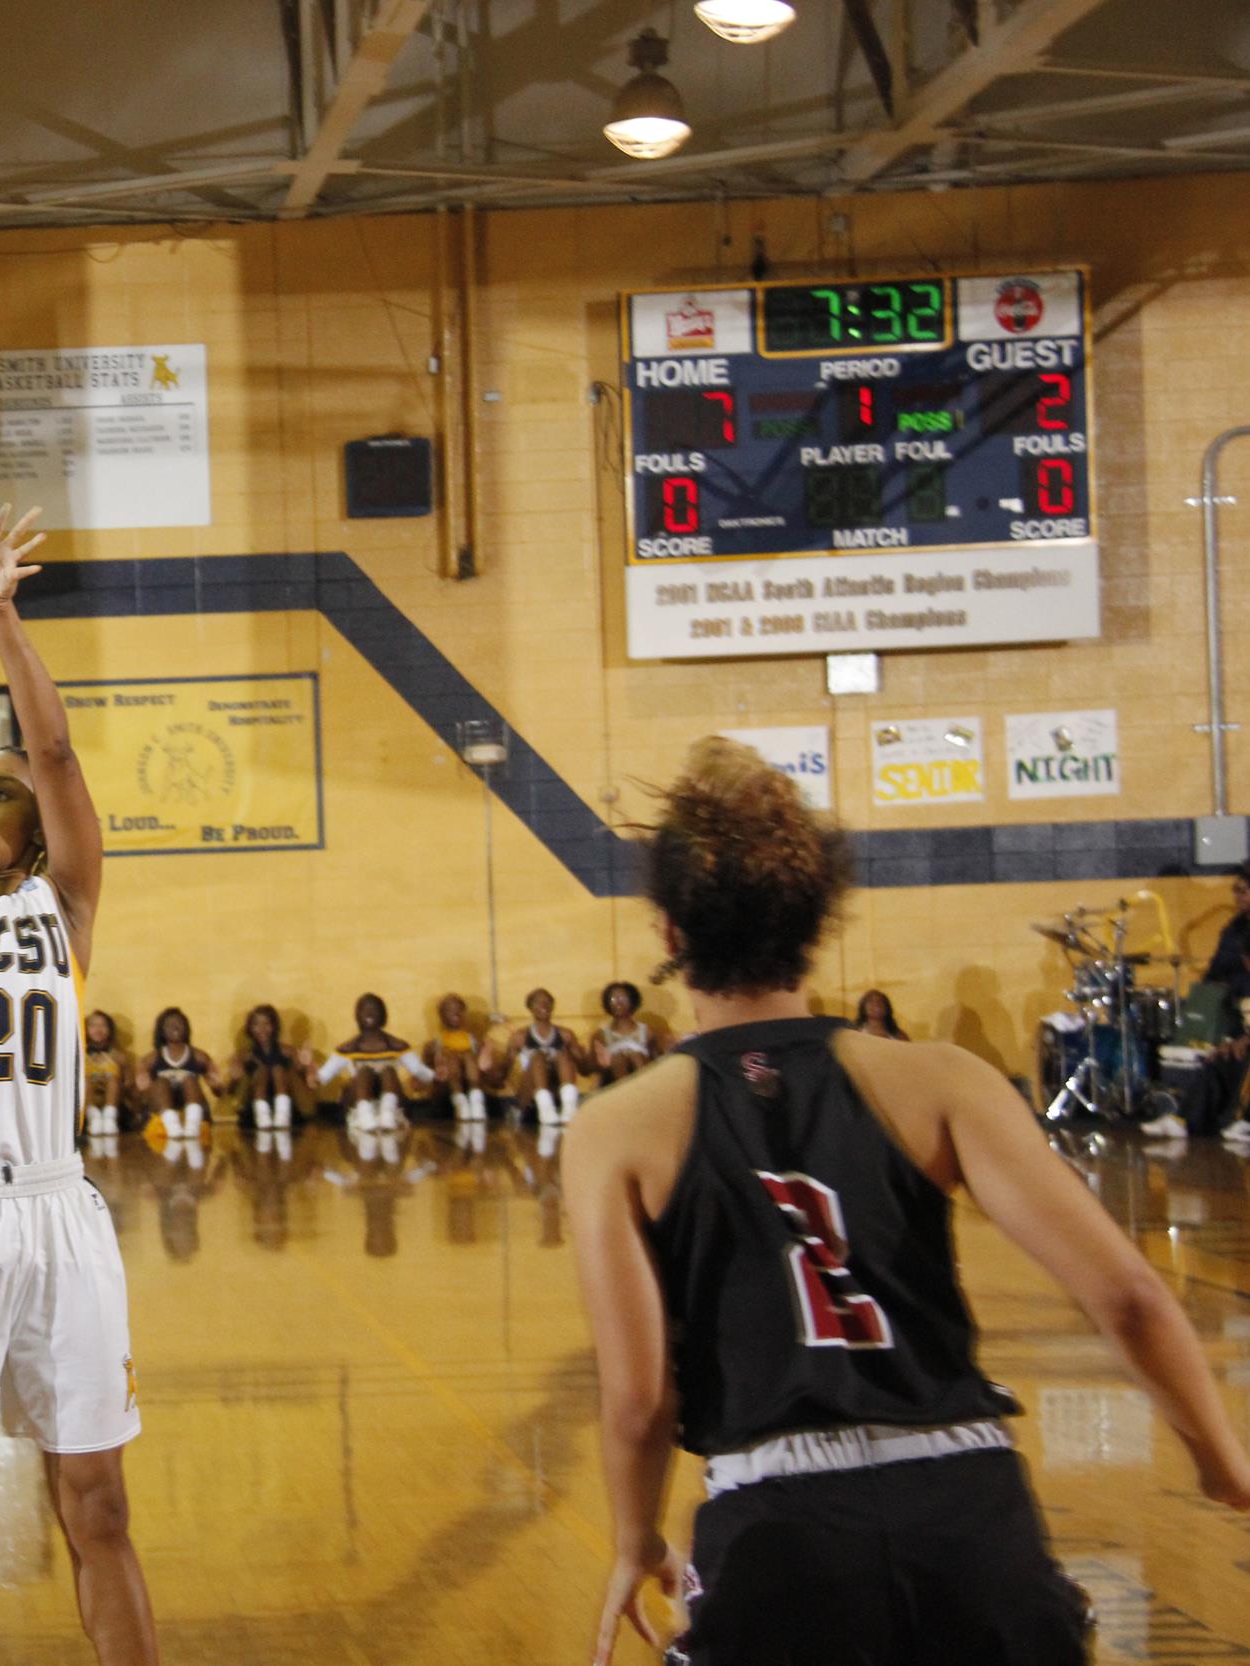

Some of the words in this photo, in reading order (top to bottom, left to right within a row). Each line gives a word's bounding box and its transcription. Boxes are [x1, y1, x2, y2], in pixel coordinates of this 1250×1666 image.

[811, 284, 942, 341] 7:32
[0, 357, 47, 372] SMITH
[53, 354, 145, 371] UNIVERSITY
[967, 340, 1078, 371] GUEST
[91, 371, 139, 388] STATS
[636, 358, 729, 388] HOME
[820, 359, 901, 380] PERIOD
[858, 386, 873, 426] 1
[1036, 374, 1071, 430] 2
[702, 391, 735, 444] 7
[897, 410, 953, 433] POSS
[800, 444, 885, 466] PLAYER
[895, 440, 952, 461] FOUL
[1012, 433, 1086, 456] FOULS
[635, 453, 706, 474] FOULS
[1037, 458, 1073, 515] 0
[662, 477, 698, 533] 0
[833, 528, 908, 549] MATCH
[1010, 518, 1086, 540] SCORE
[638, 536, 713, 558] SCORE
[763, 578, 814, 600] South
[973, 567, 1071, 591] Champions
[865, 607, 967, 631] Champions
[1014, 752, 1117, 785] NIGHT
[201, 825, 225, 842] BE
[754, 1169, 896, 1349] 2
